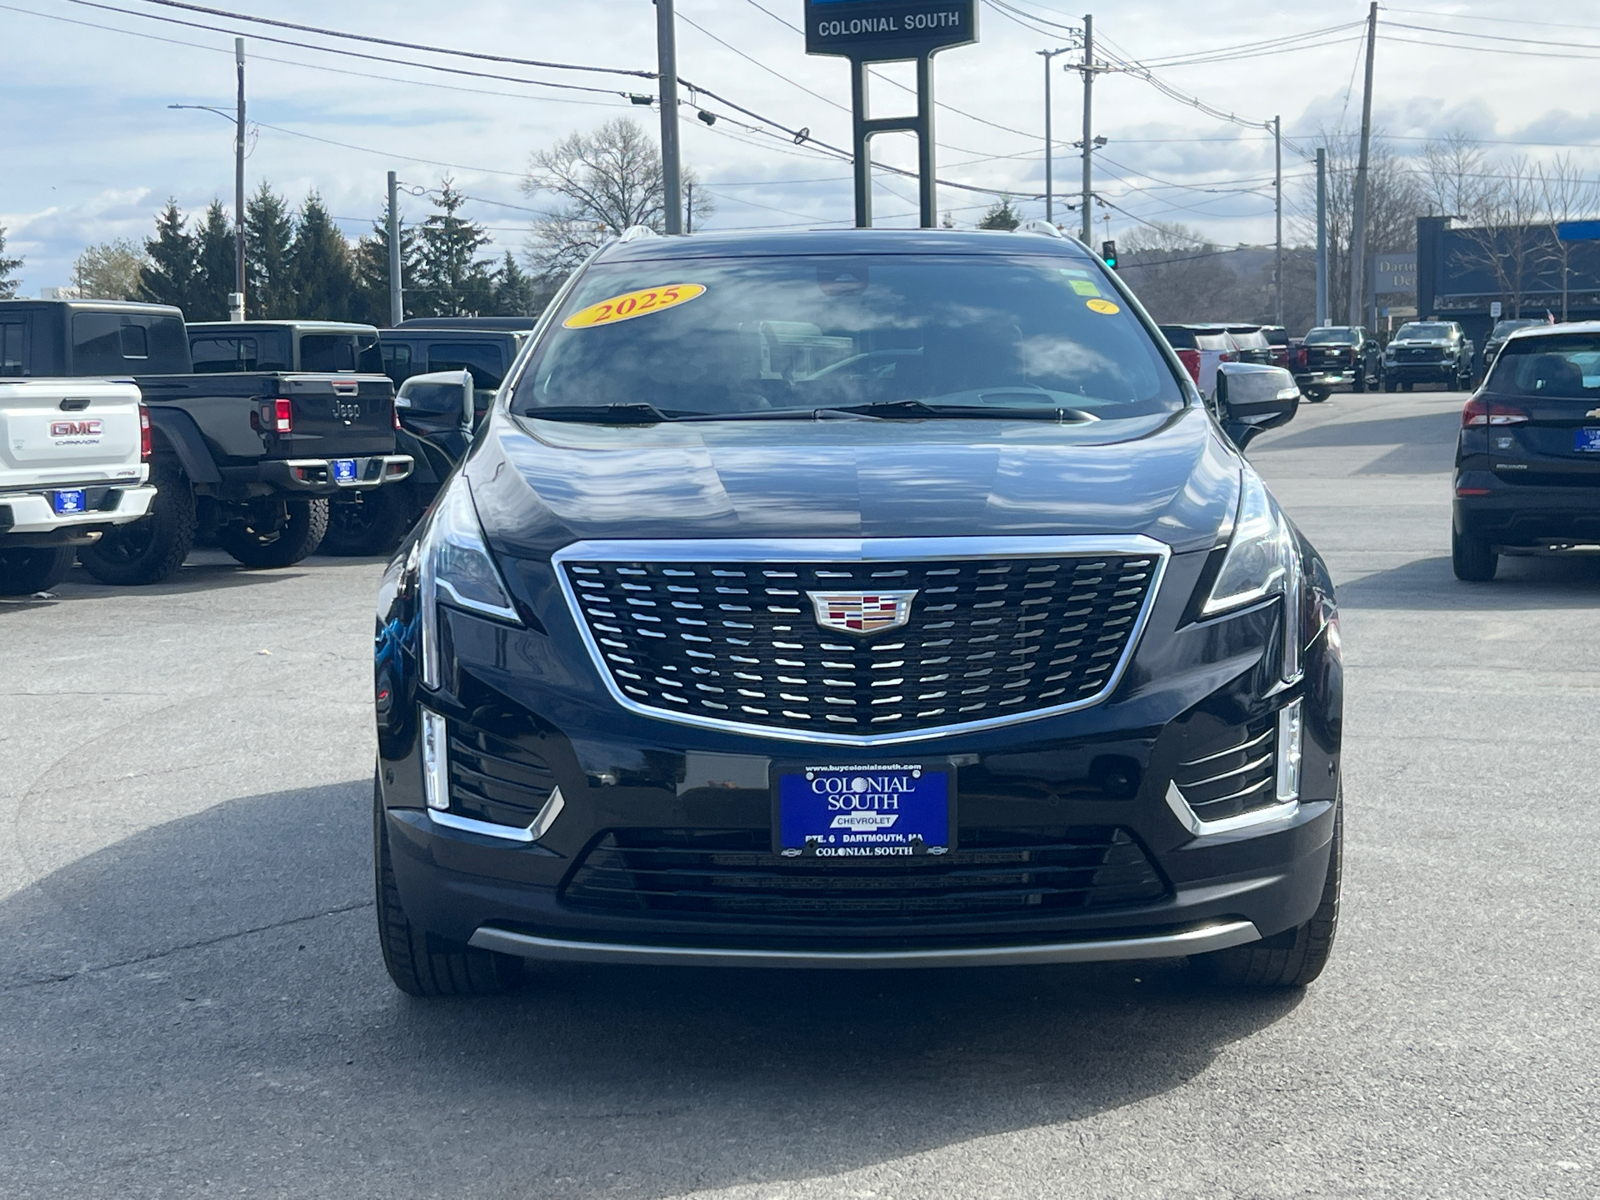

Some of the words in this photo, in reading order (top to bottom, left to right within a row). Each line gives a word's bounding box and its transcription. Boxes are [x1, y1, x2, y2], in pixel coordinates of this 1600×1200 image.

[818, 16, 899, 37] COLONIAL
[904, 11, 960, 30] SOUTH
[593, 286, 682, 323] 2025
[332, 399, 361, 421] Jeep
[52, 421, 102, 436] GMC
[805, 764, 922, 773] www.buycolonialsouth.com
[812, 776, 916, 794] COLONIAL
[827, 793, 900, 811] SOUTH
[837, 817, 892, 825] CHEVROLET
[828, 834, 836, 843] 6
[842, 834, 907, 844] DARTMOUTH,
[815, 846, 873, 857] COLONIAL
[874, 846, 914, 856] SOUTH
